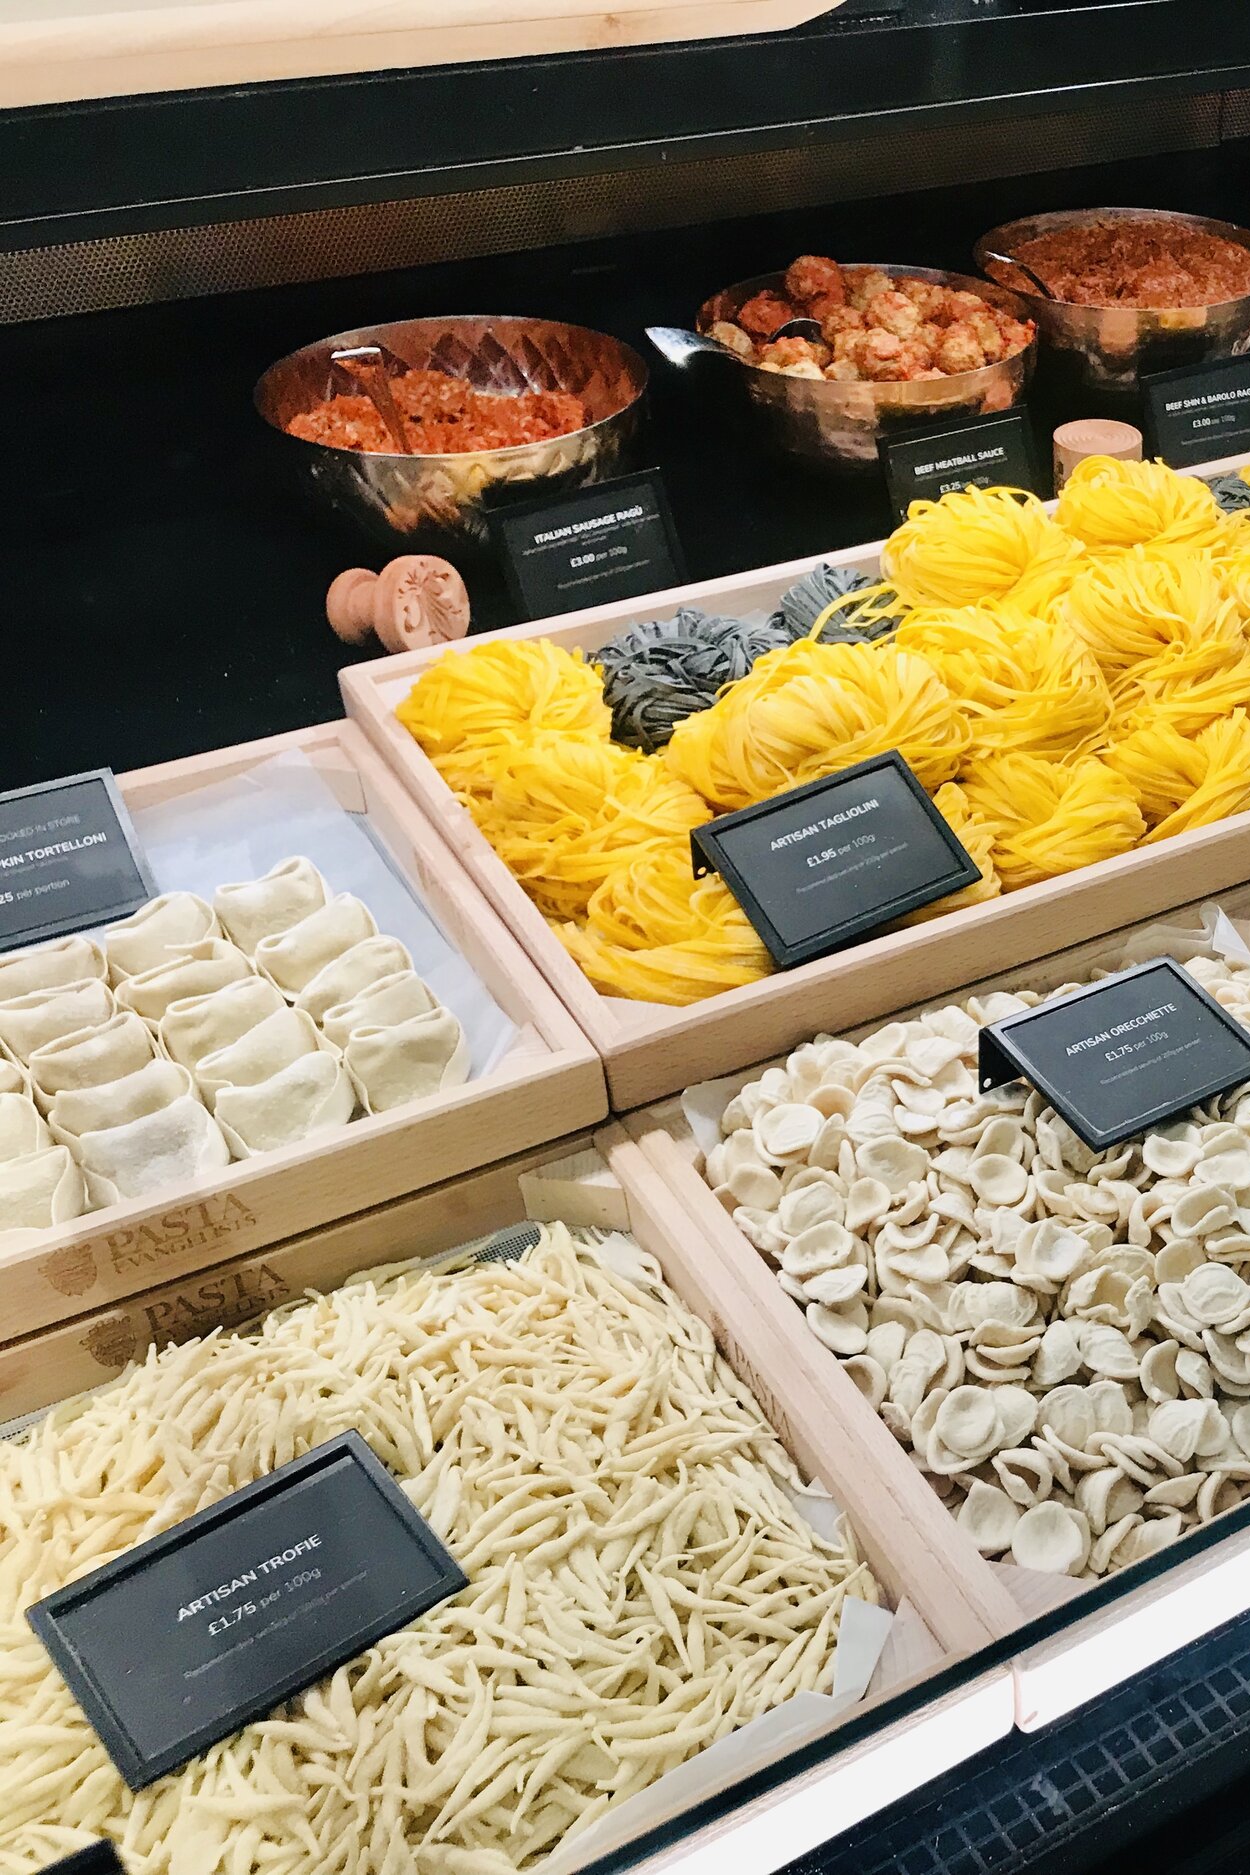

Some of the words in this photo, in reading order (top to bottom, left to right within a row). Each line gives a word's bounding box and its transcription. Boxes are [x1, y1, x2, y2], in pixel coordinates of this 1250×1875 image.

[1165, 401, 1182, 411] BEEF
[1183, 398, 1200, 408] SHIN
[1201, 396, 1207, 405] &
[1207, 391, 1236, 403] BAROLO
[1192, 417, 1211, 428] £3.00
[914, 463, 935, 476] BEEF
[935, 454, 977, 470] MEATBALL
[978, 447, 1004, 460] SAUCE
[940, 481, 961, 494] £3.25
[534, 525, 572, 544] ITALIAN
[573, 513, 616, 533] SAUSAGE
[47, 814, 81, 830] STORE
[770, 823, 820, 851] ARTISAN
[818, 799, 880, 830] TAGLIOLINI
[25, 831, 107, 863] TORTELLONI
[806, 848, 837, 868] £1.95
[838, 844, 851, 856] per
[851, 834, 876, 849] 100g
[16, 889, 32, 901] per
[35, 879, 70, 897] portion
[1065, 1031, 1112, 1056] ARTISAN
[1110, 1003, 1177, 1038] ORECCHIETTE
[1104, 1044, 1133, 1062] £1.75
[1134, 1039, 1147, 1052] per
[1147, 1031, 1169, 1045] 100g
[104, 1193, 251, 1262] PASTA
[143, 1264, 284, 1333] PASTA
[177, 1570, 257, 1622] ARTISAN
[257, 1534, 322, 1575] TROFIE
[208, 1601, 257, 1636] £1.75
[259, 1590, 282, 1609] per
[284, 1567, 322, 1593] 100g
